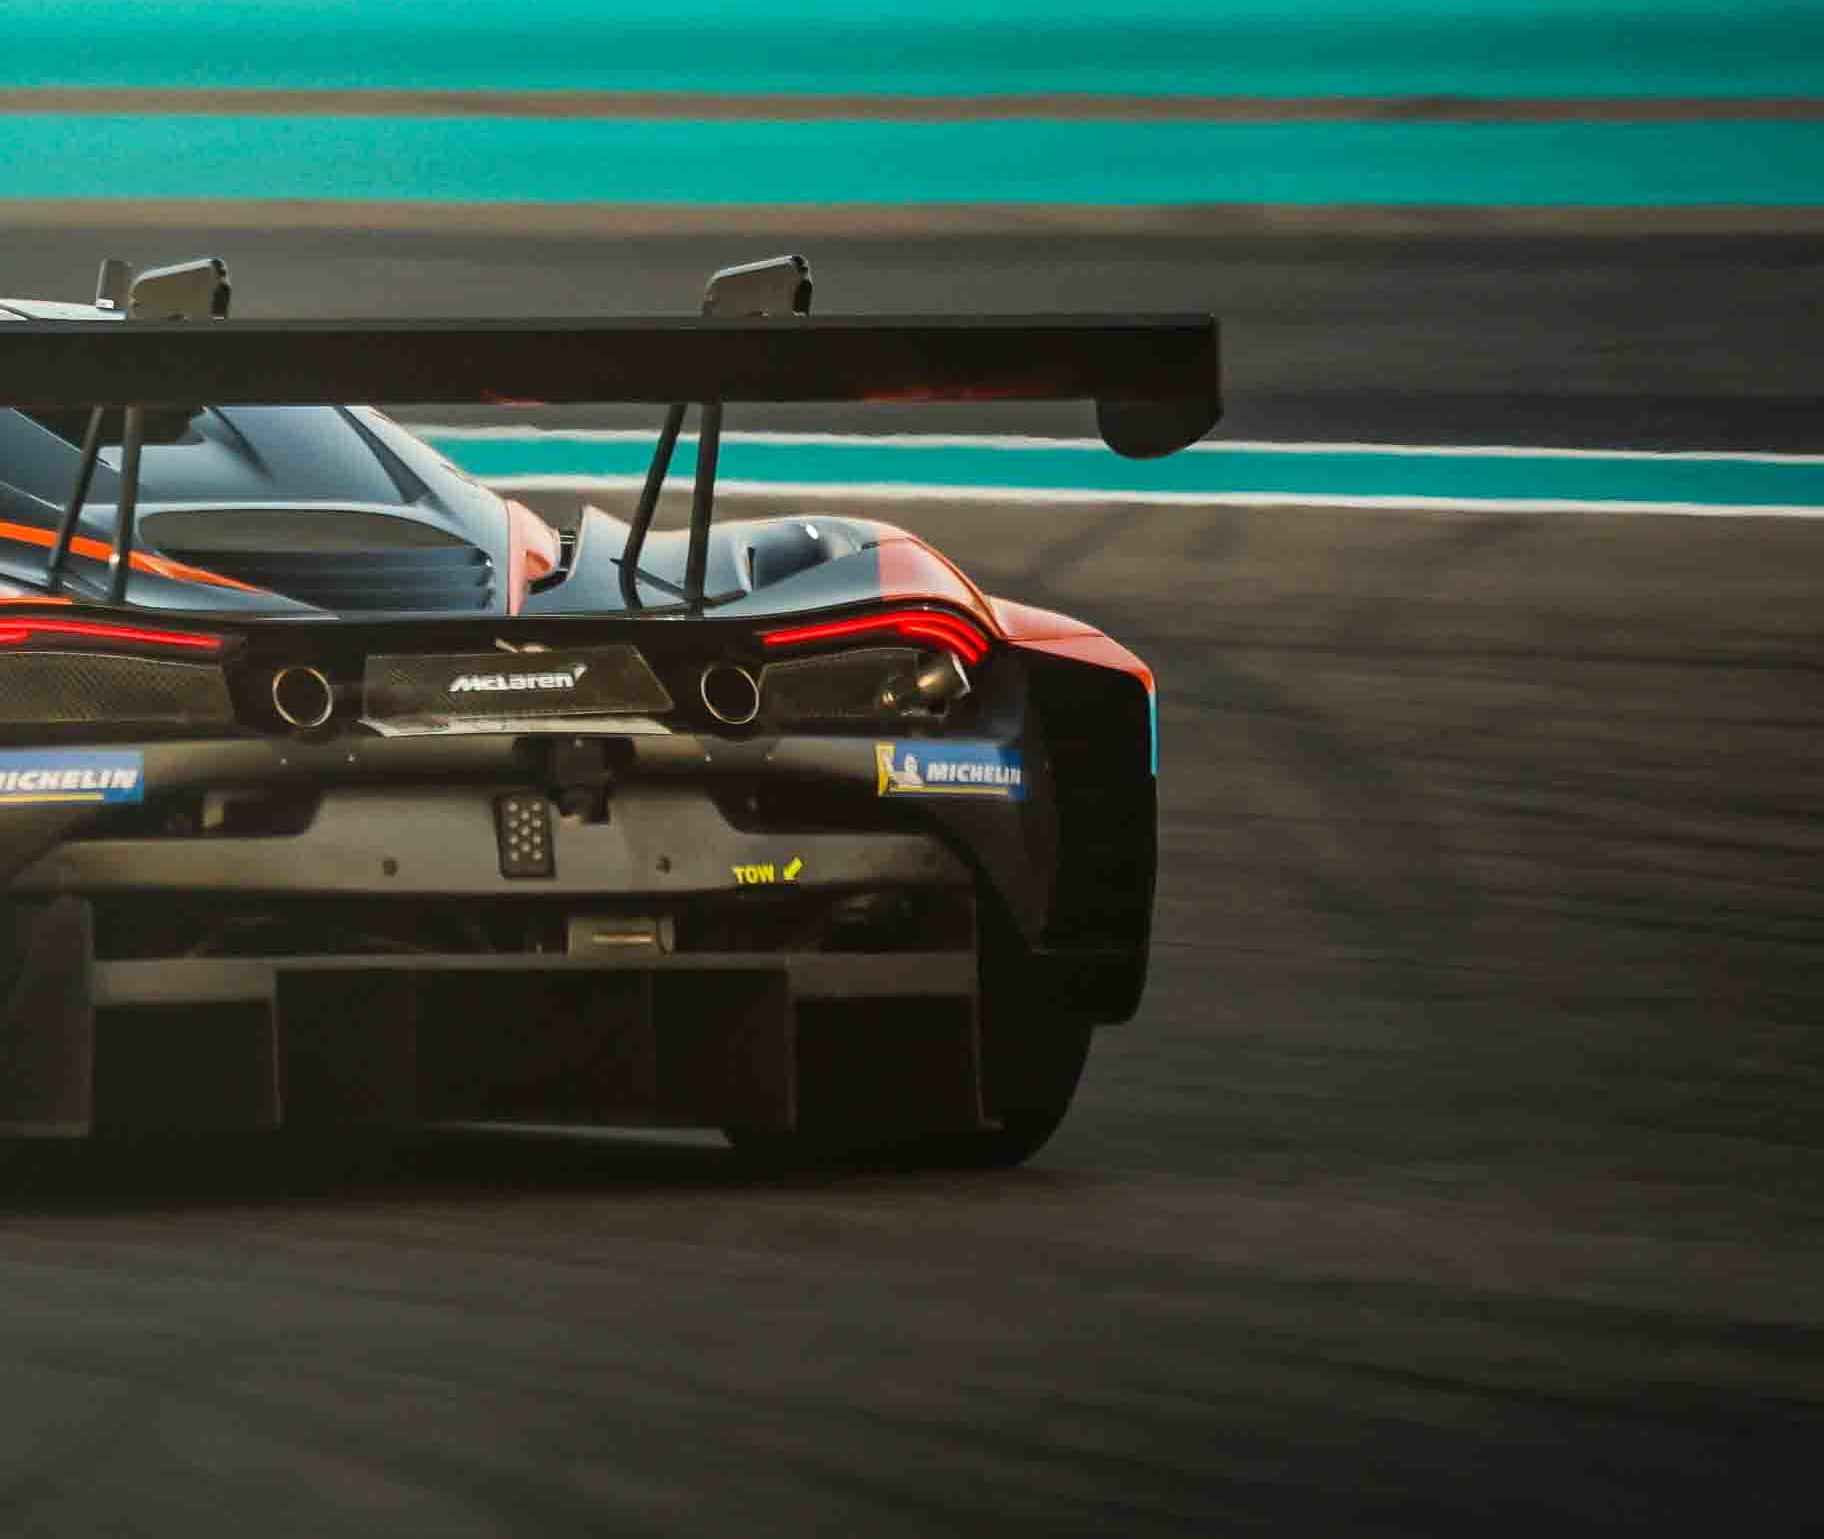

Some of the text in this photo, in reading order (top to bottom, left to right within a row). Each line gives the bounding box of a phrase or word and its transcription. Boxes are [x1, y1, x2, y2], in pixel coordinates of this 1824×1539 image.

[449, 672, 575, 692] McLaren
[926, 762, 1022, 786] MICHELIN
[733, 863, 775, 885] TOW
